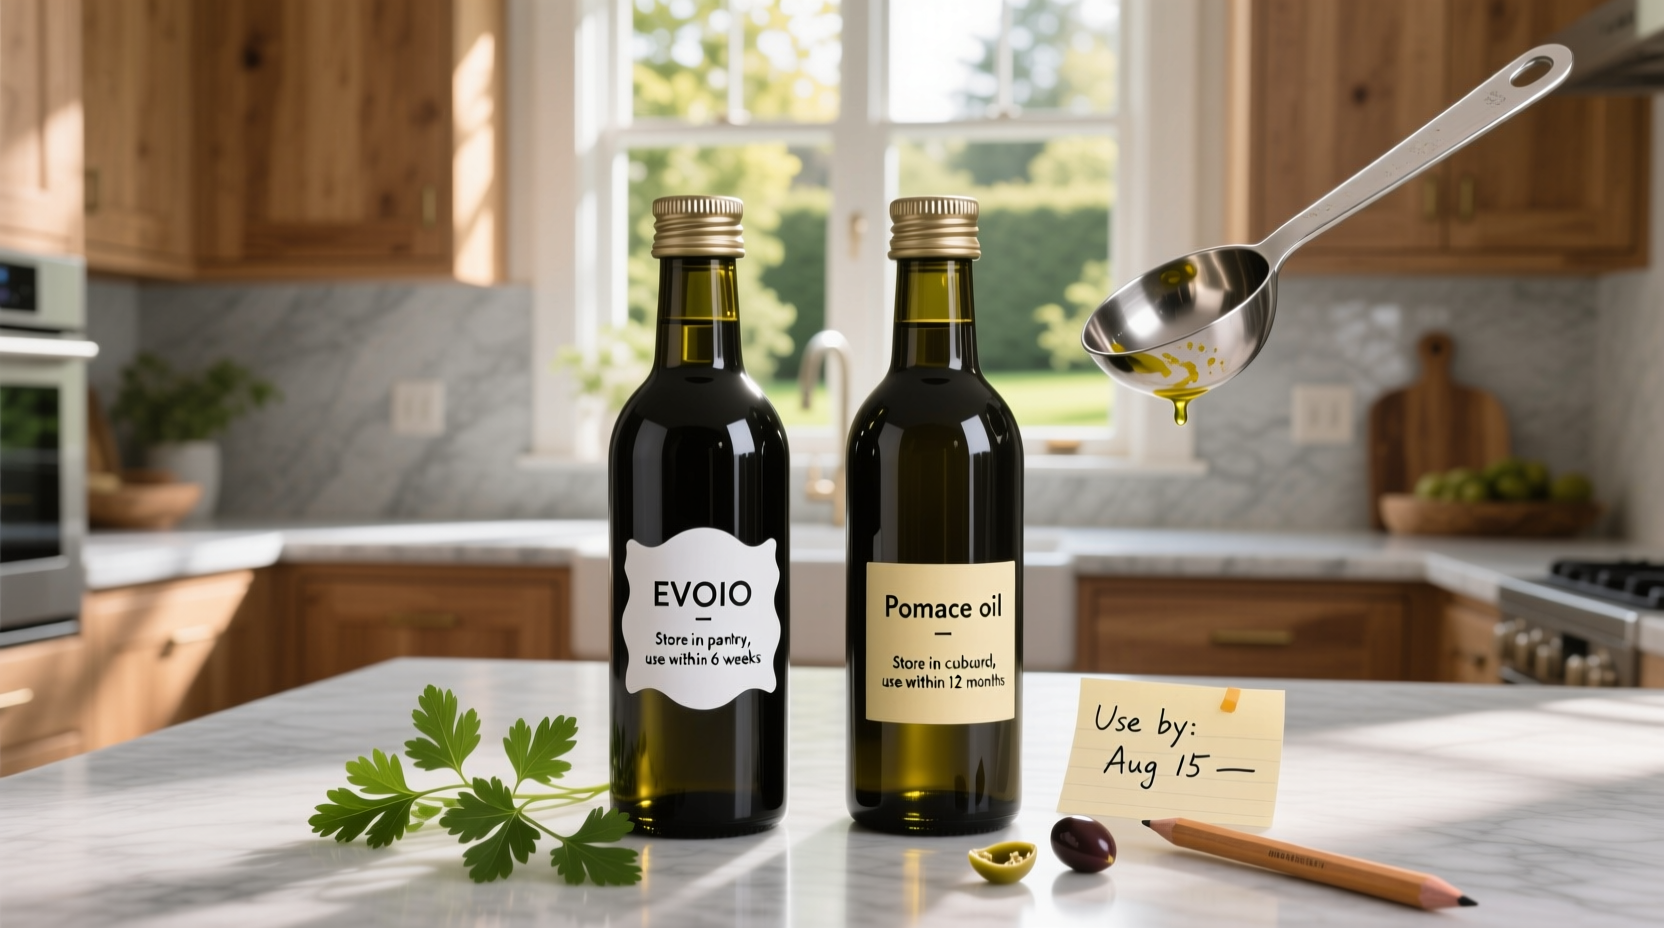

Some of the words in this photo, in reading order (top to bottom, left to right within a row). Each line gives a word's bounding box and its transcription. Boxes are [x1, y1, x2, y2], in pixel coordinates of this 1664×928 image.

[653, 580, 752, 608] EVOIO
[885, 594, 973, 619] Pomace
[979, 592, 1003, 618] oil
[655, 631, 689, 646] Store
[691, 632, 704, 646] in
[707, 632, 751, 651] pantry,
[645, 654, 666, 665] use
[669, 651, 707, 666] within
[711, 652, 720, 665] 6
[723, 649, 762, 666] weeks
[892, 655, 926, 670] Store
[929, 656, 941, 670] in
[882, 677, 903, 688] use
[905, 674, 945, 689] within
[949, 674, 962, 689] 12
[966, 673, 1005, 689] months
[1095, 704, 1142, 733] Use
[1157, 708, 1197, 748] by:
[1103, 745, 1158, 790] Aug
